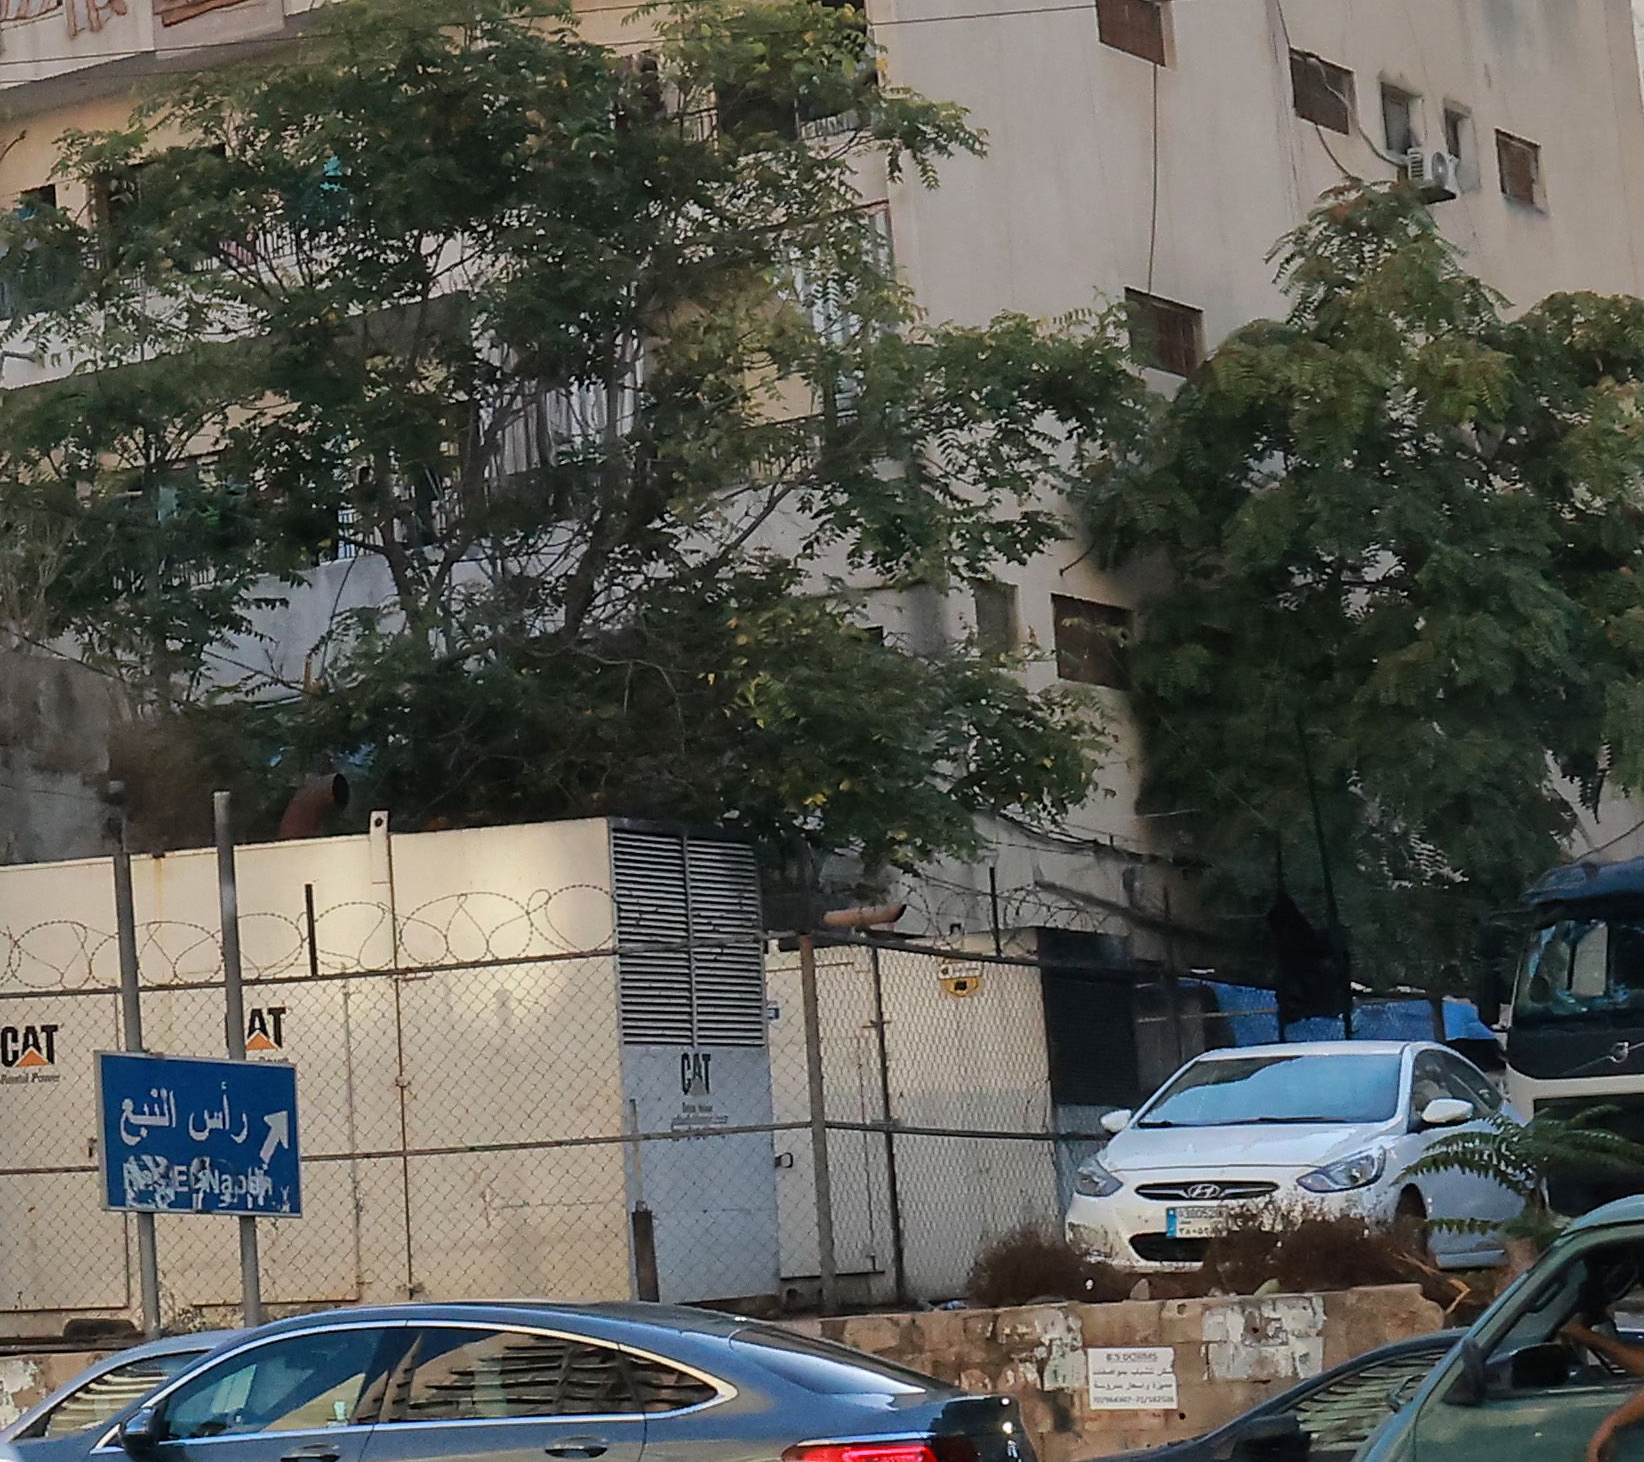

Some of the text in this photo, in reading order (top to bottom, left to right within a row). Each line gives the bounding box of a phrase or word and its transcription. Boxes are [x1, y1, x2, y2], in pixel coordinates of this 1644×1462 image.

[0, 1024, 59, 1068] CAT
[680, 1052, 712, 1096] CAT
[120, 1080, 249, 1146] رأس النبع
